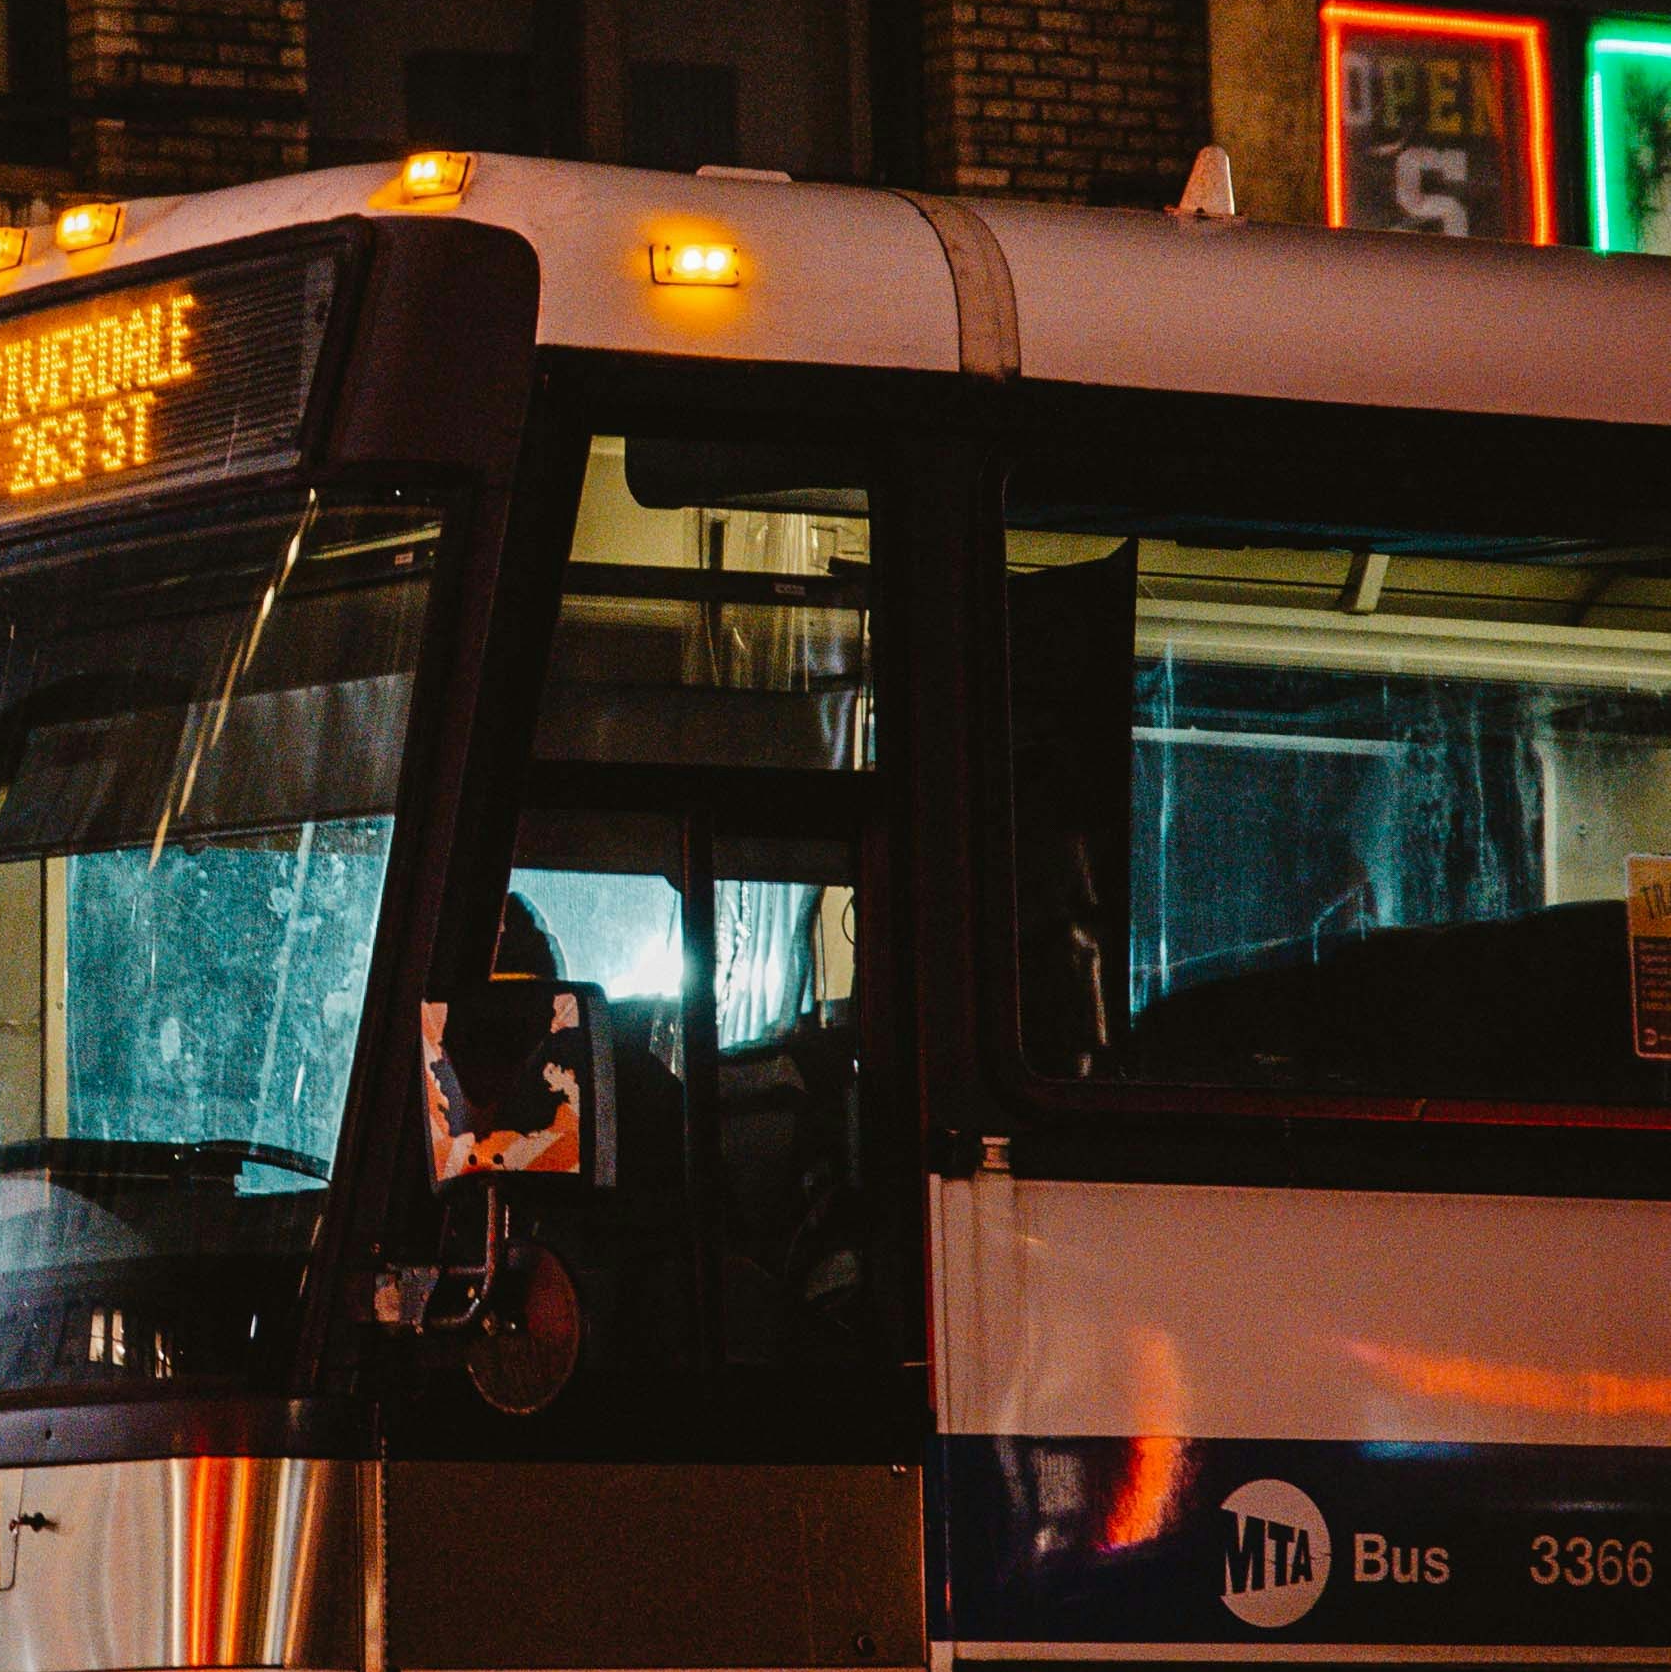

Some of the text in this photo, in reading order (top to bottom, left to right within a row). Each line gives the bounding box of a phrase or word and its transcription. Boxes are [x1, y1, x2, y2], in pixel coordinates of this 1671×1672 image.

[1341, 50, 1505, 140] OPEN
[10, 391, 157, 493] 263 ST
[1222, 1509, 1654, 1594] MTA Bus 3366
